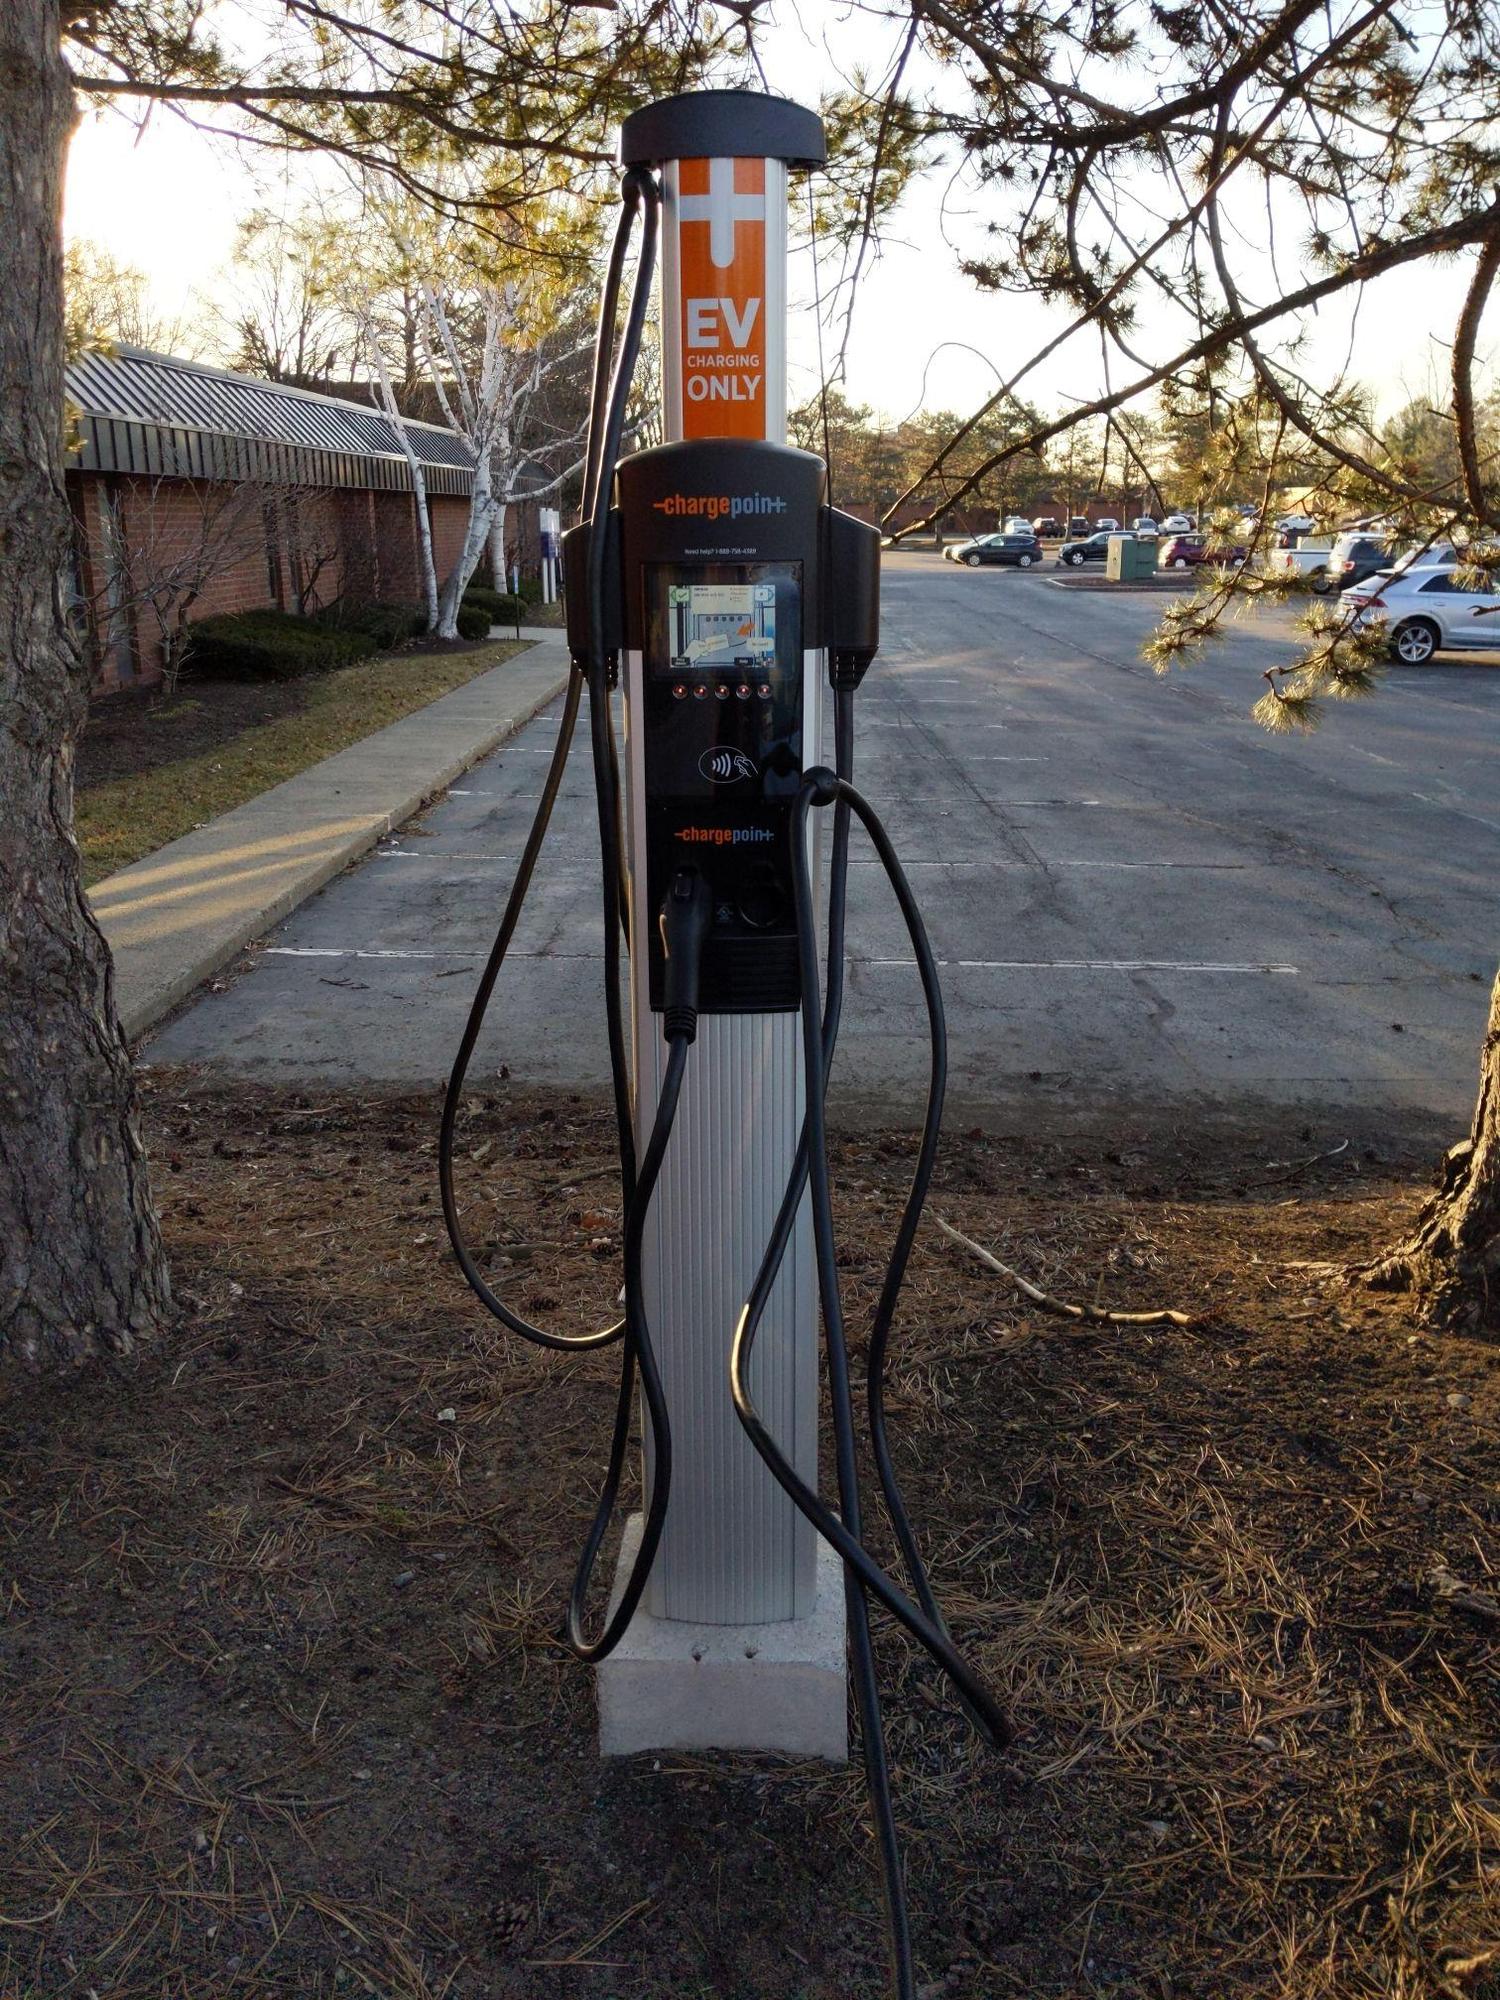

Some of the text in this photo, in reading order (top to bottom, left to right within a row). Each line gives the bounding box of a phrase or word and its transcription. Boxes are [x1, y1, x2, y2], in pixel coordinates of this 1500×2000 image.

[687, 298, 761, 348] EV
[687, 354, 760, 368] CHARGING
[687, 375, 761, 401] ONLY
[654, 492, 787, 520] chargepoint
[674, 826, 774, 845] chargepoint
